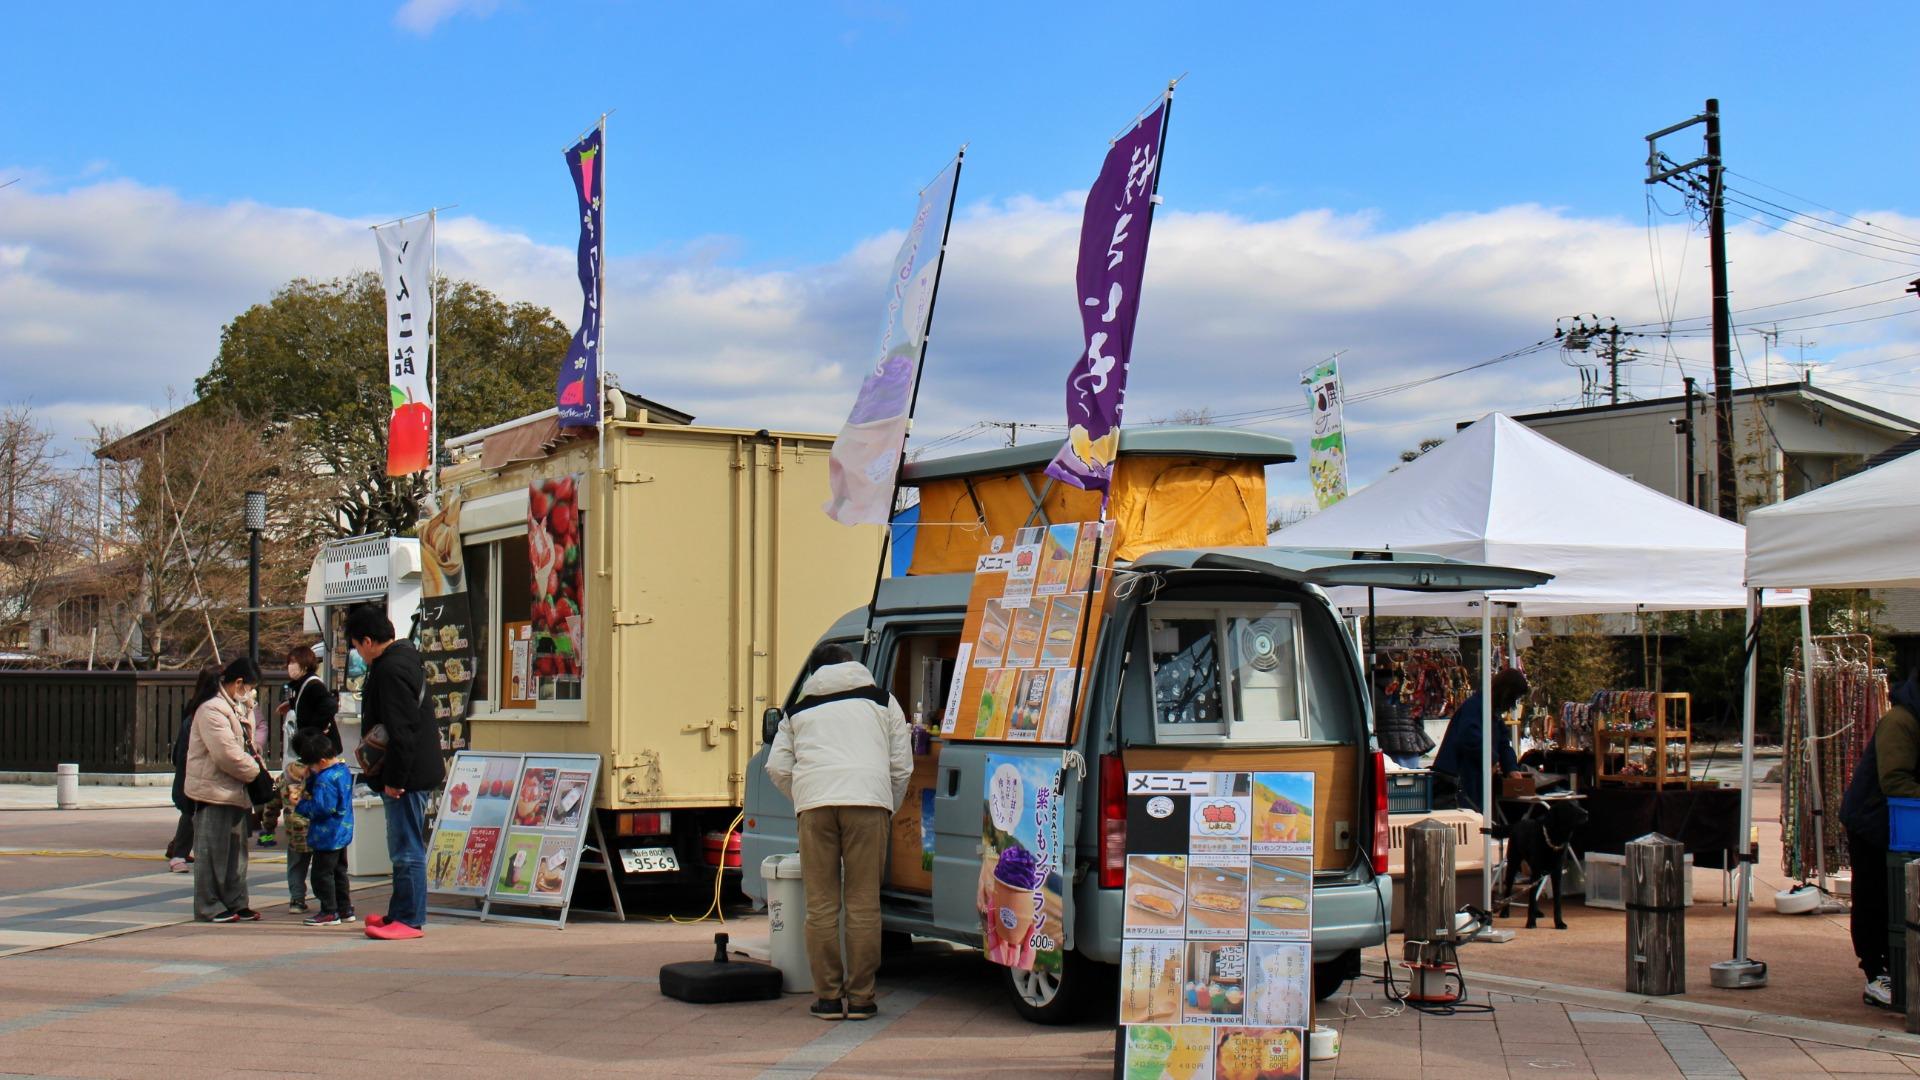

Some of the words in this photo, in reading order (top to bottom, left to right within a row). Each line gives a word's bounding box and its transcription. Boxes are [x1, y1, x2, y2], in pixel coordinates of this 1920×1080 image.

[977, 556, 1011, 571] メニュー
[1132, 775, 1208, 792] メニュー
[1208, 823, 1232, 831] しました
[634, 856, 676, 870] 95-69
[1032, 786, 1050, 930] 紫いもンブラン
[1029, 934, 1054, 950] 600円
[1220, 953, 1243, 962] メロン
